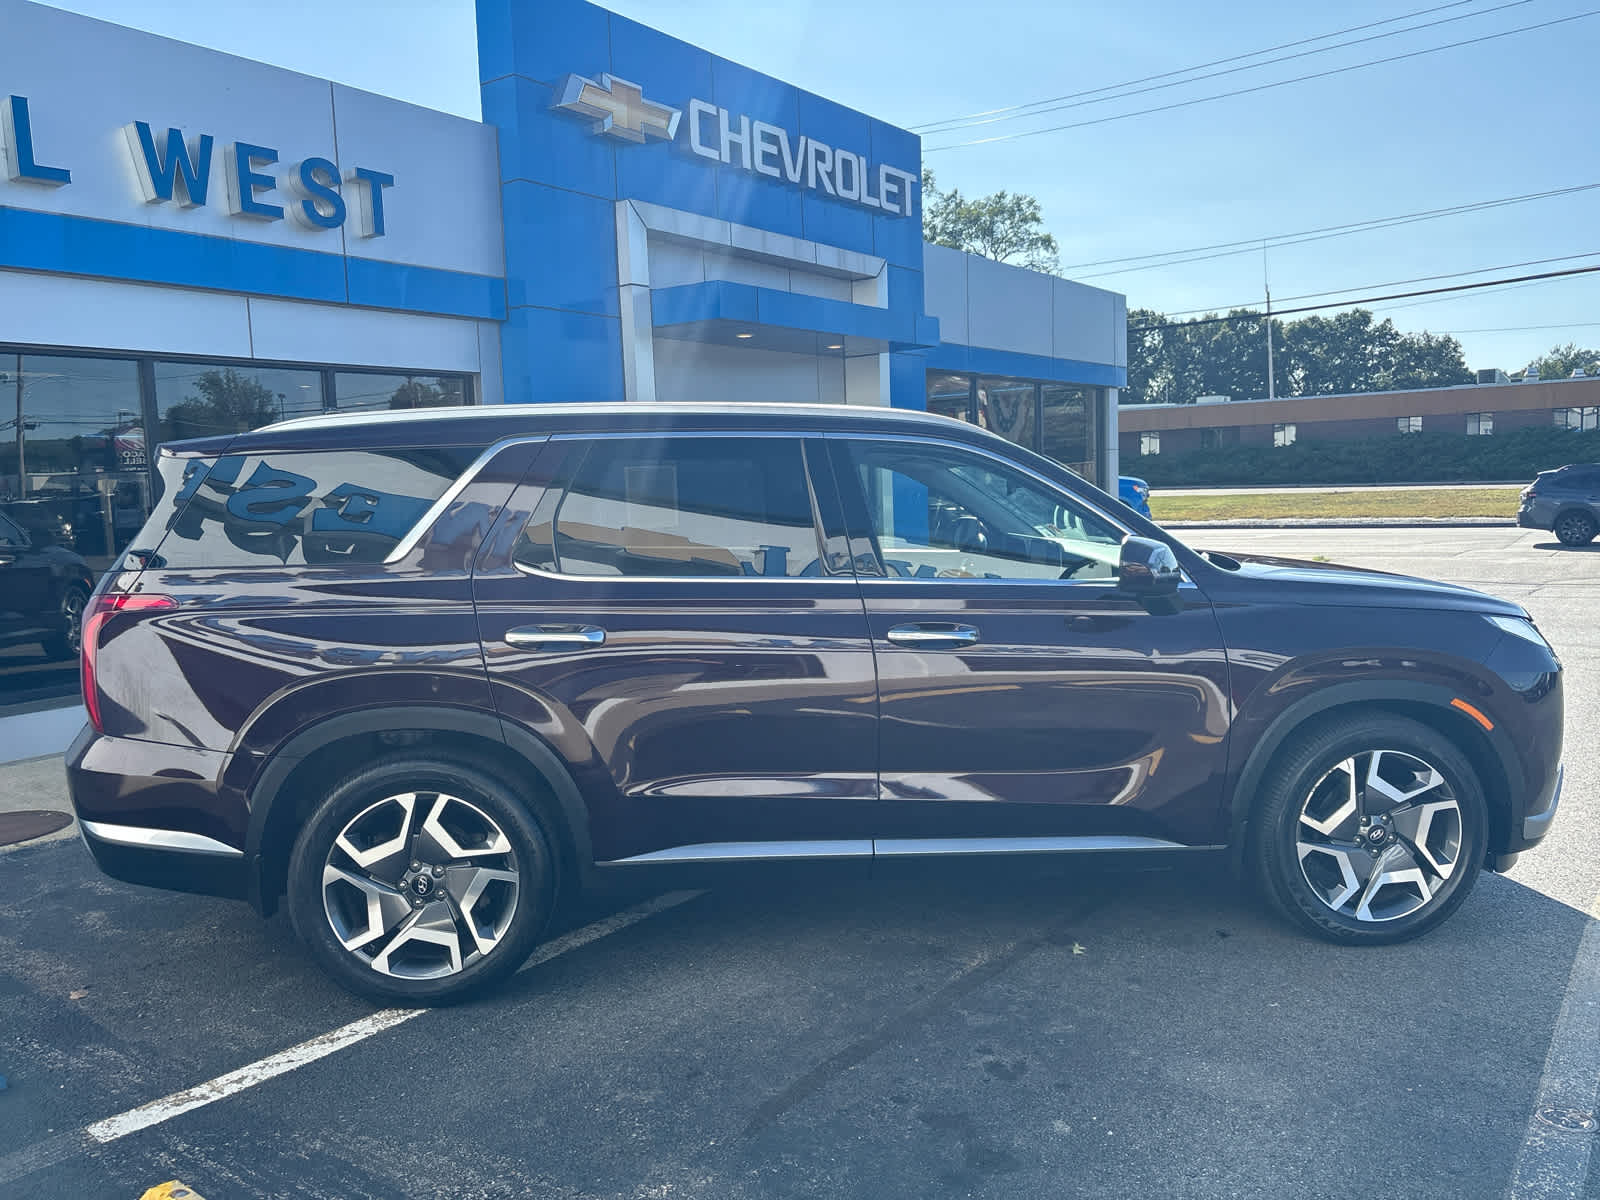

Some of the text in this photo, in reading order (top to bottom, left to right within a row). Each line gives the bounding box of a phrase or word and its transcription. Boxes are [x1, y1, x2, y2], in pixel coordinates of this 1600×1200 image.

[5, 95, 395, 238] L WEST
[689, 98, 918, 217] CHEVROLET
